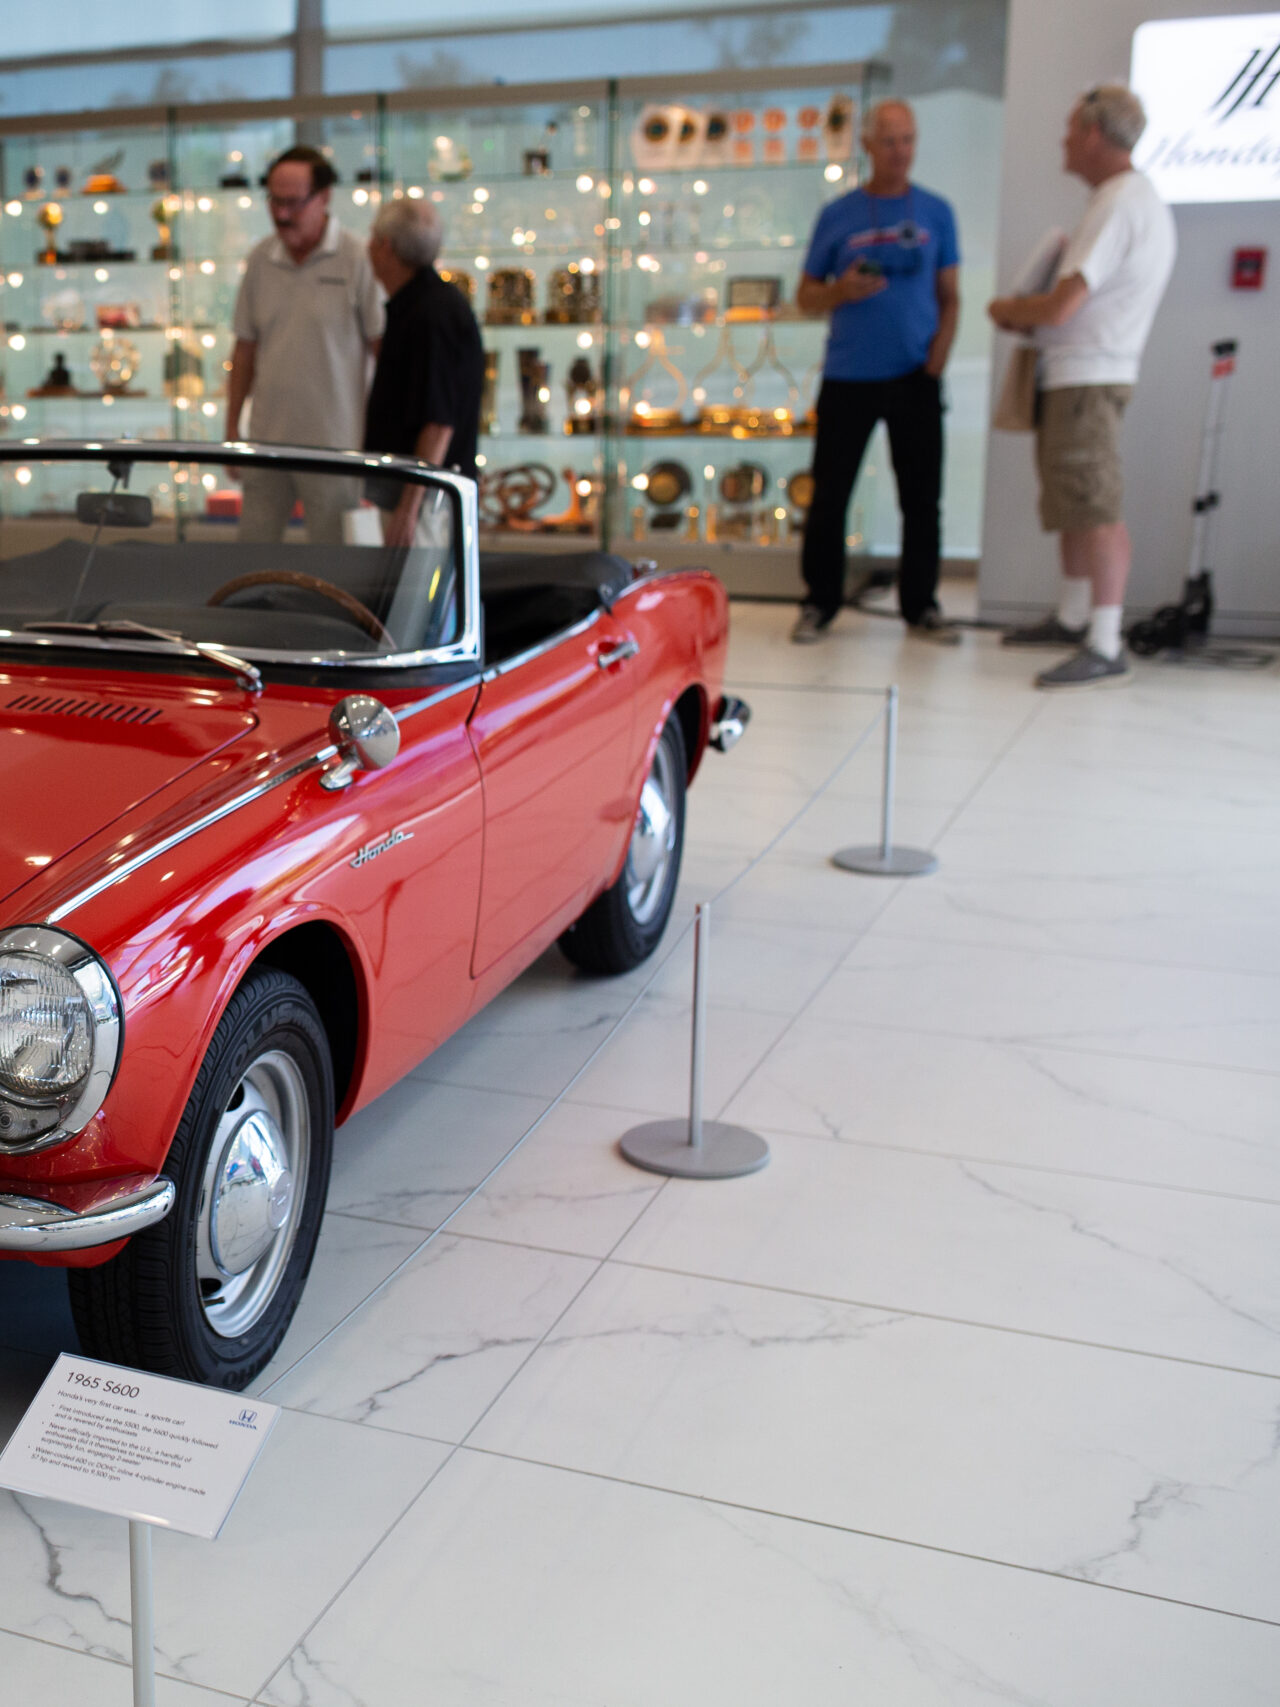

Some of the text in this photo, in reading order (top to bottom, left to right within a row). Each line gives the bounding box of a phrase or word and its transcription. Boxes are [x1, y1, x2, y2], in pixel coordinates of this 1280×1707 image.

[1144, 132, 1280, 182] Honda
[350, 828, 414, 868] Honda
[67, 1371, 140, 1398] 1965 S600
[229, 1419, 257, 1430] HONDA
[49, 1422, 67, 1431] Never
[160, 1450, 184, 1460] handful
[168, 1433, 191, 1443] quickly
[95, 1462, 117, 1471] DOHC
[136, 1453, 169, 1464] experience
